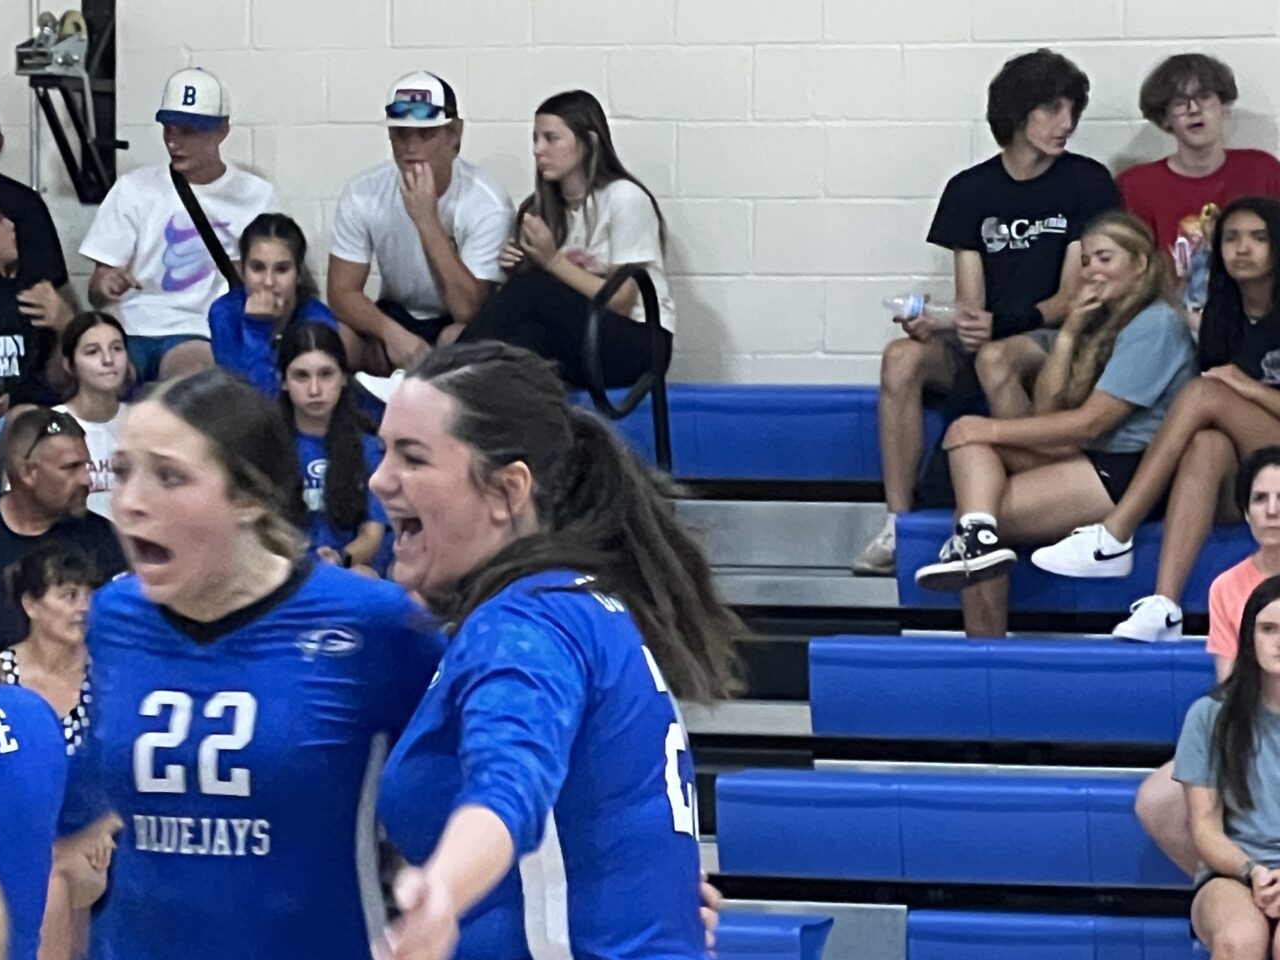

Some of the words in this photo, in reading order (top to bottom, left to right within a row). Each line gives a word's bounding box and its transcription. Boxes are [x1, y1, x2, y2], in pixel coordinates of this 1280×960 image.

[182, 85, 196, 106] B
[133, 690, 257, 796] 22
[133, 815, 270, 856] BLUEJAYS
